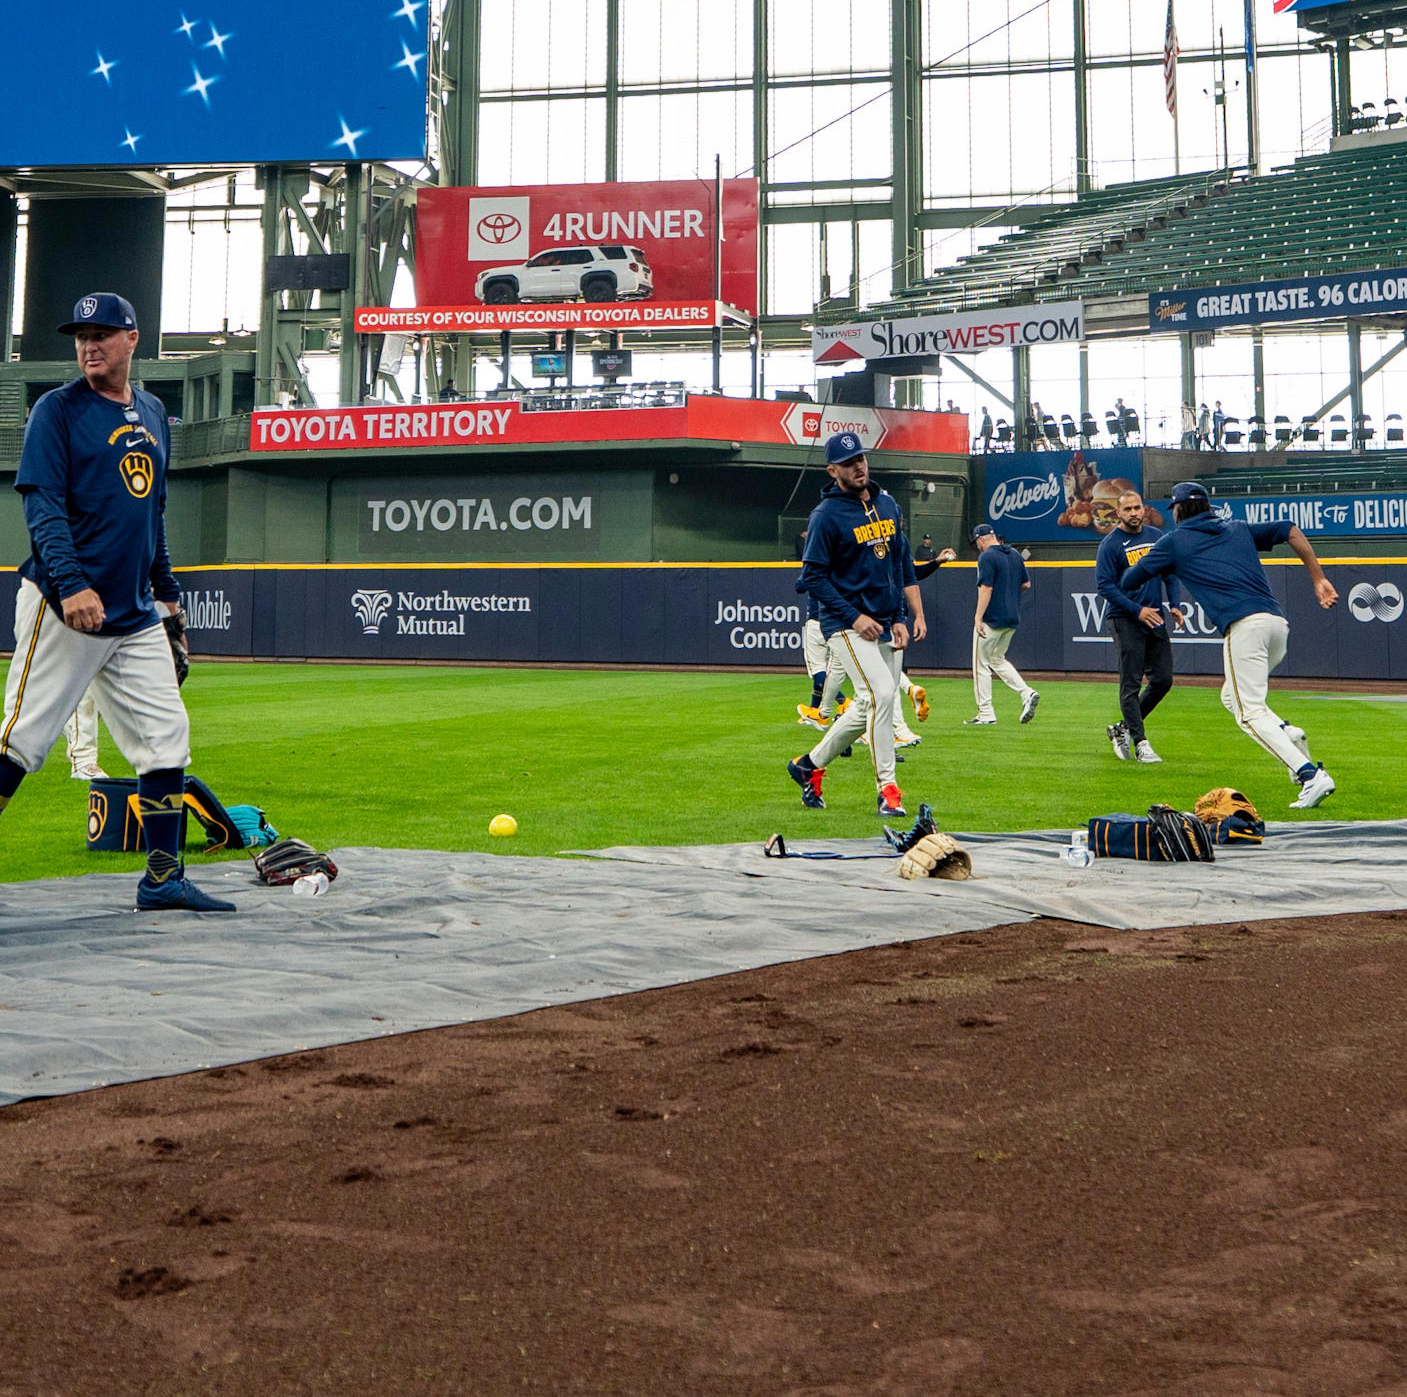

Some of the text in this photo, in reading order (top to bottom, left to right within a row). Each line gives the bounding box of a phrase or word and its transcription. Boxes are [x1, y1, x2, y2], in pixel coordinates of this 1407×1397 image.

[542, 209, 705, 242] 4RUNNER
[1196, 290, 1253, 319] GREAT
[1255, 285, 1315, 313] TASTE.
[1317, 282, 1345, 307] 96
[358, 306, 709, 326] COURTESY OF YOUR WISCONSIN TOYOTA DEALERS
[1171, 312, 1187, 322] TIME
[870, 316, 1081, 356] ShoreWEST.COM
[1195, 333, 1208, 346] 101
[257, 409, 512, 444] TOYOTA TERRITORY
[824, 419, 869, 435] TOYOTA
[988, 472, 1061, 521] Culver's
[367, 496, 593, 533] TOYOTA.COM
[853, 519, 896, 544] BREWERS
[186, 590, 232, 630] Mobile
[396, 591, 532, 612] Northwestern
[714, 599, 800, 625] Johnson
[396, 615, 466, 636] Mutual
[730, 626, 805, 650] Control
